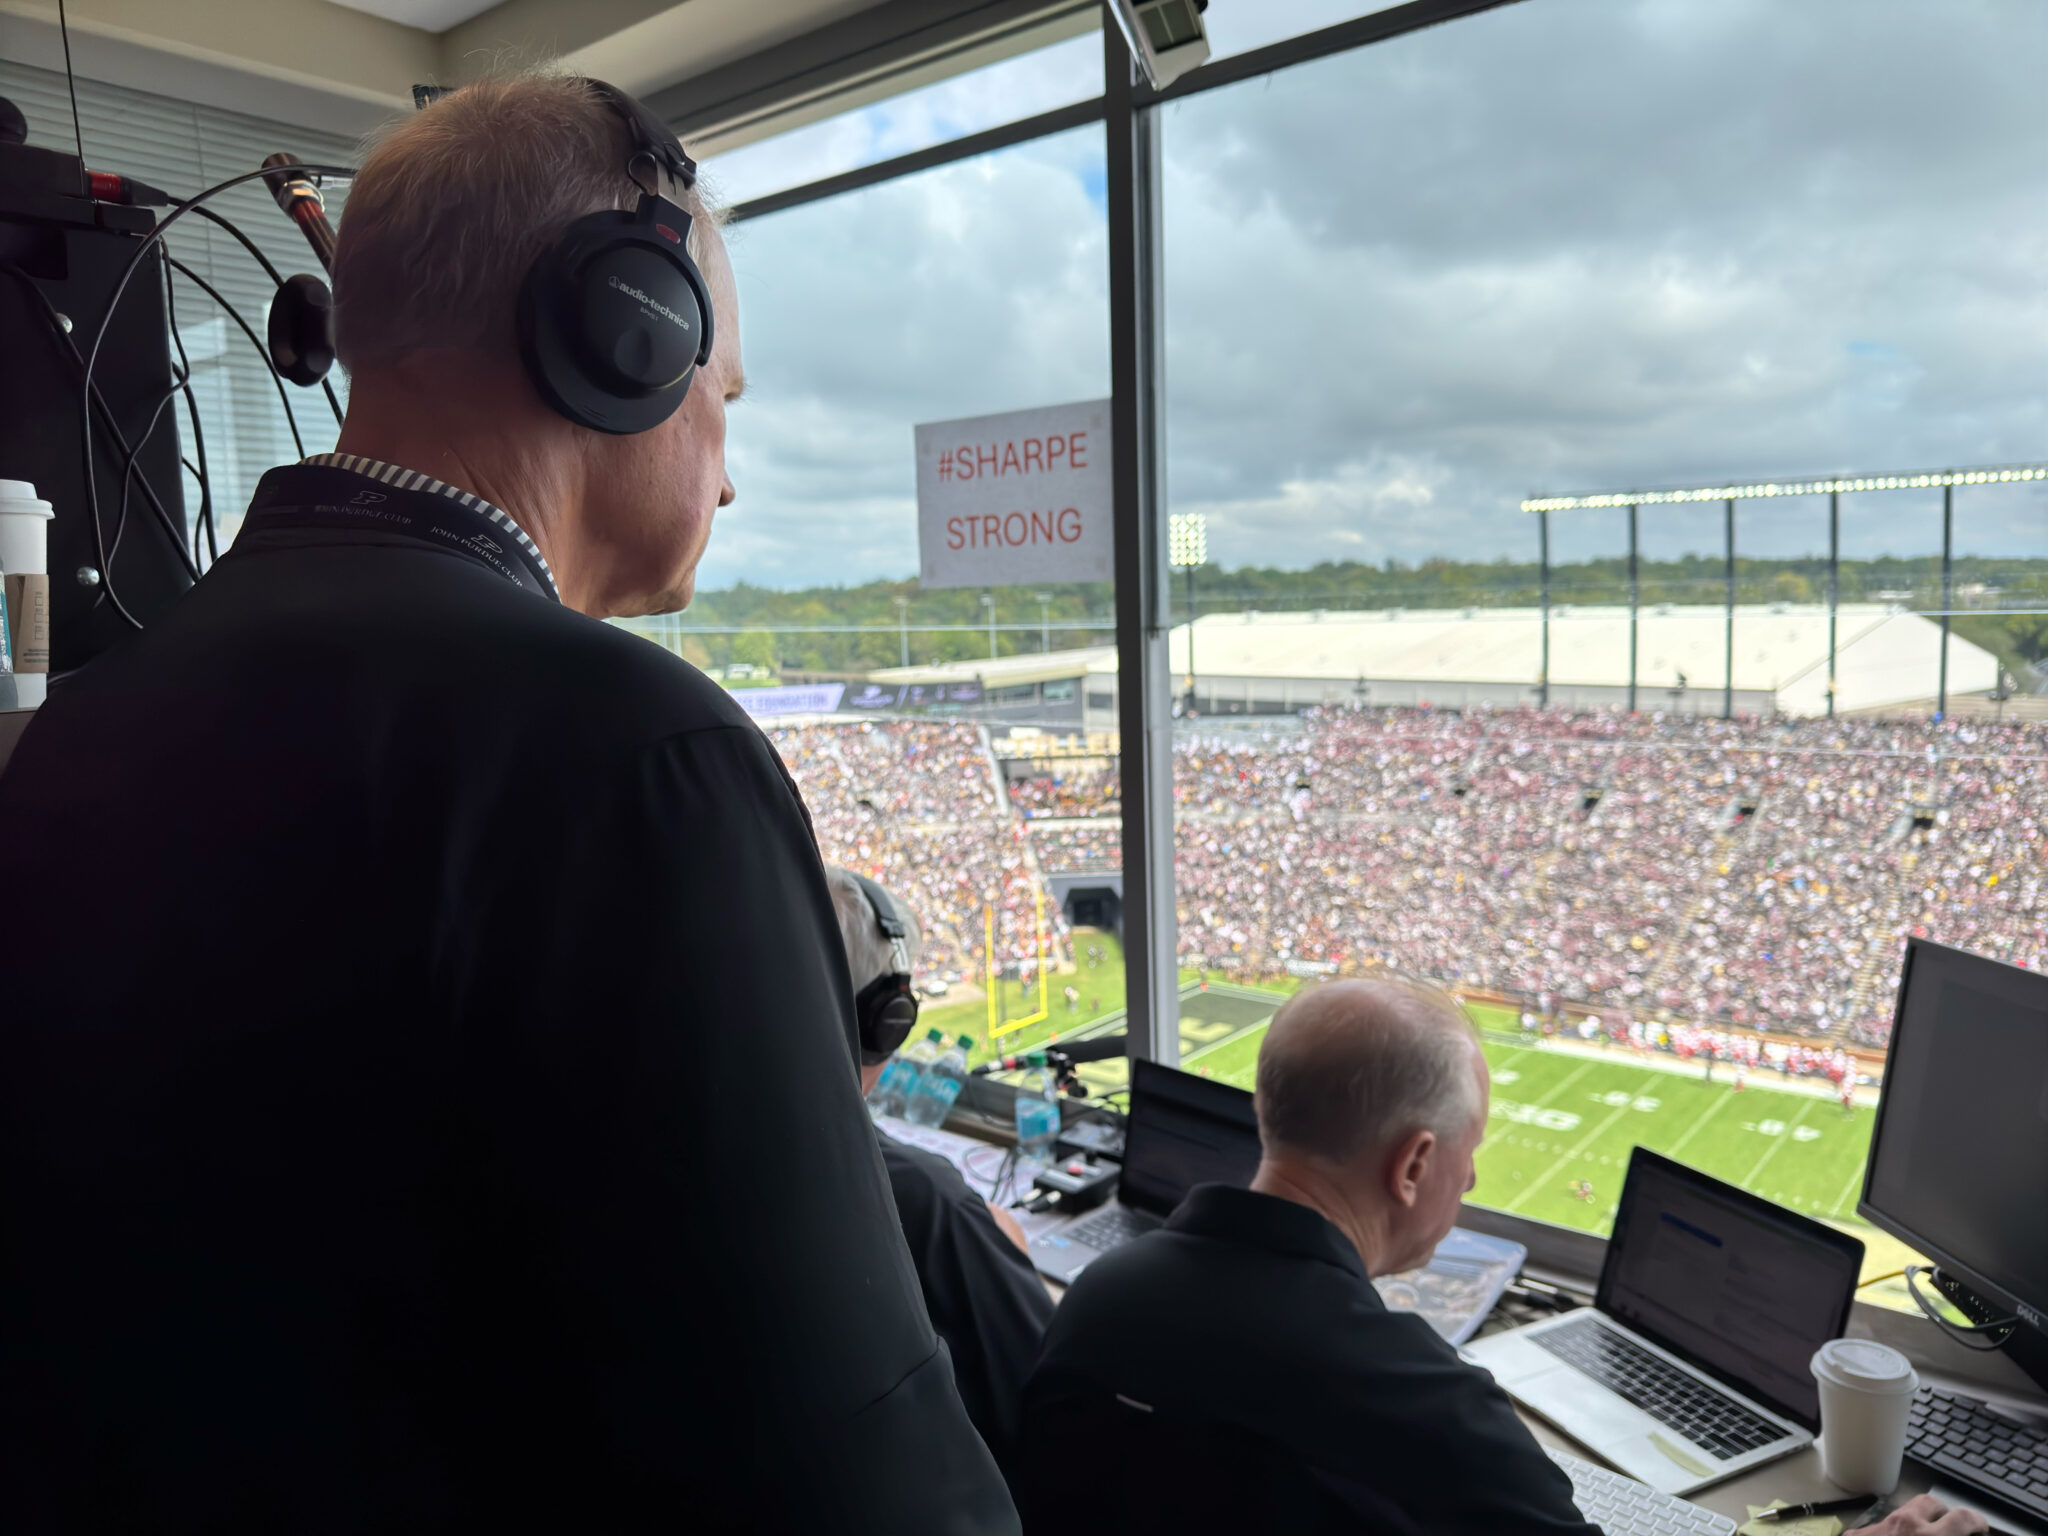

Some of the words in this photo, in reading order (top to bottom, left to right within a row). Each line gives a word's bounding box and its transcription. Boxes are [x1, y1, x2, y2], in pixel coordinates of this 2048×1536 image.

[619, 283, 690, 331] audio-technica
[937, 431, 1089, 483] #SHARPE
[430, 526, 460, 541] JOHN
[460, 538, 502, 568] PURDUE
[946, 507, 1083, 551] STRONG
